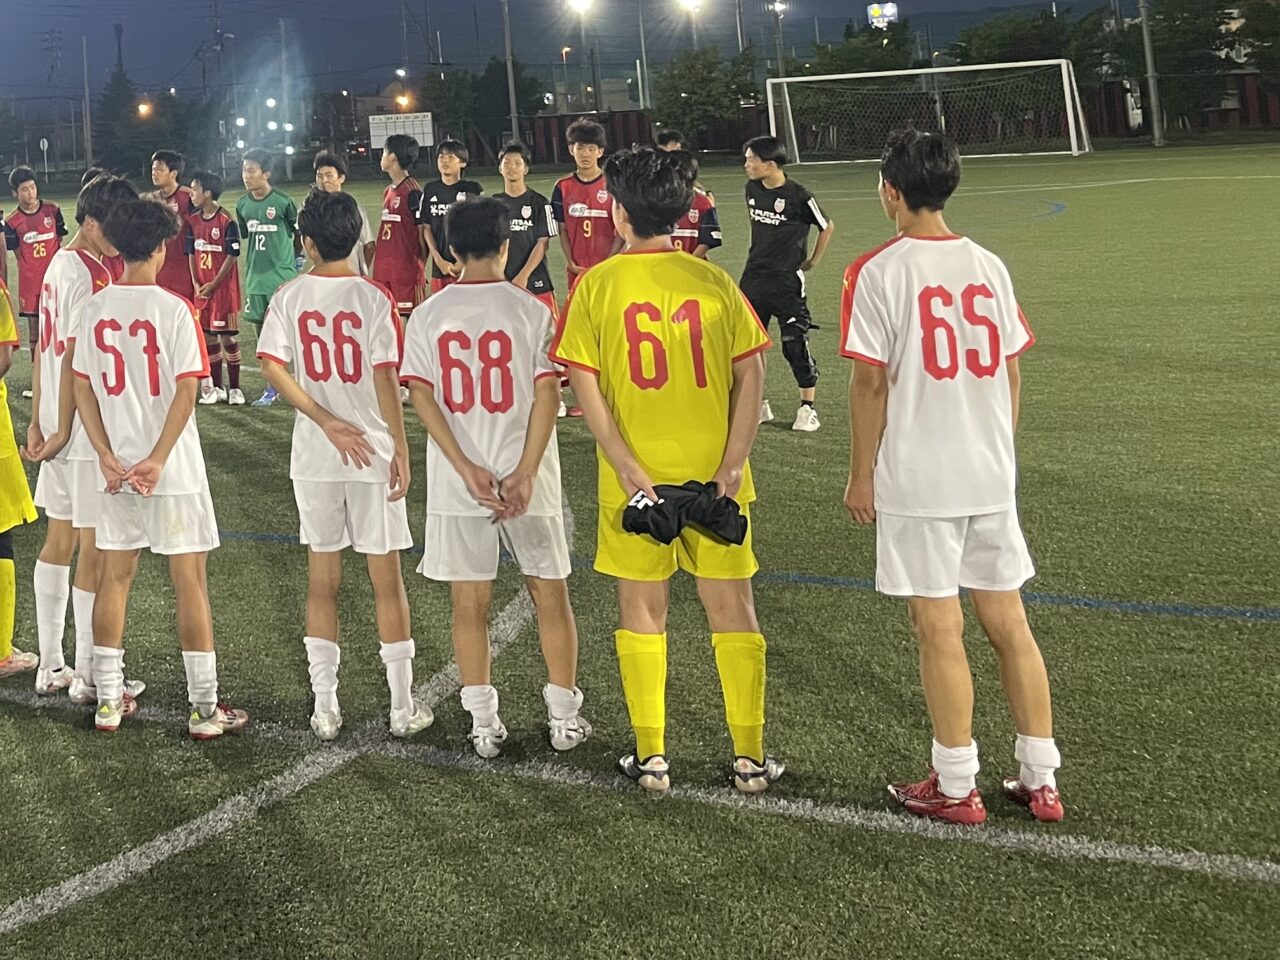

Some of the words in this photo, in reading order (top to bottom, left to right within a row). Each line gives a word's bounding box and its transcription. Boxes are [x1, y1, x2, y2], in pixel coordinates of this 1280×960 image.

[255, 234, 266, 251] 12
[509, 219, 533, 227] UTSAL
[583, 219, 592, 238] 9
[32, 242, 47, 258] 26
[200, 252, 212, 270] 24
[298, 310, 363, 385] 66
[623, 299, 708, 391] 61
[917, 282, 1001, 381] 65
[94, 318, 160, 397] 57
[438, 329, 515, 415] 68
